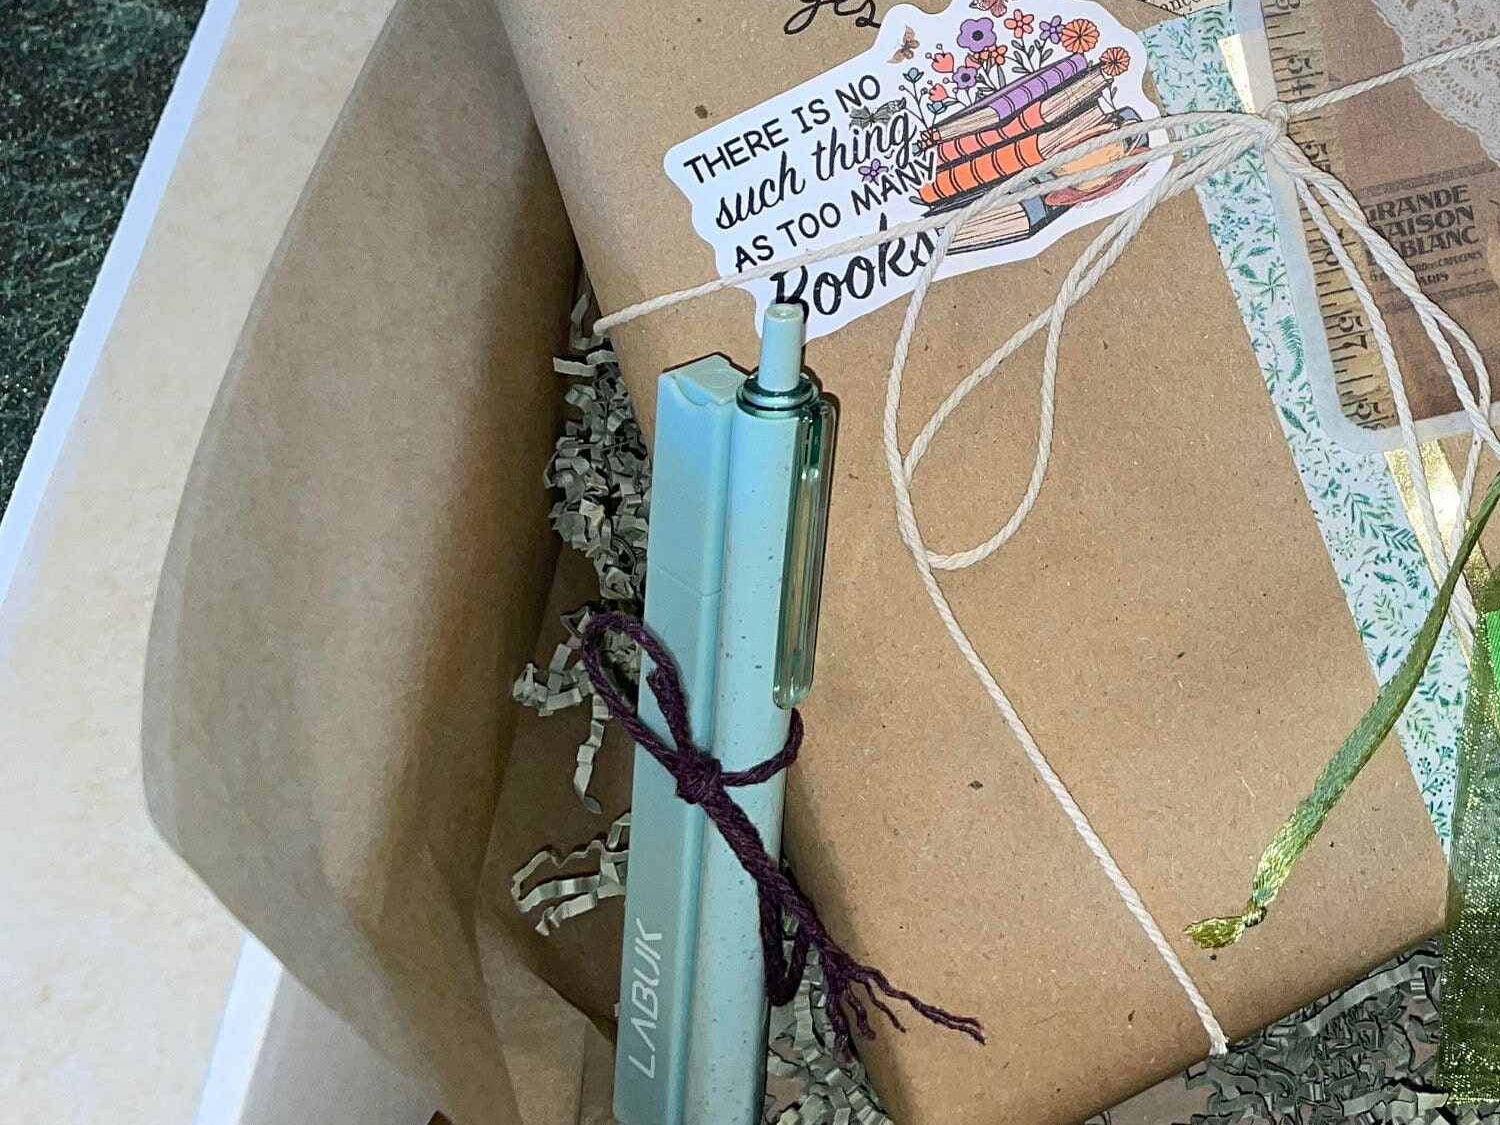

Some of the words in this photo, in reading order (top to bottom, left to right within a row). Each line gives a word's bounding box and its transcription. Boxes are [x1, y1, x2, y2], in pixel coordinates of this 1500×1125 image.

[683, 119, 788, 185] THERE
[798, 102, 831, 134] IS
[835, 74, 881, 116] NO
[715, 150, 805, 230] such
[811, 109, 919, 179] thing
[733, 235, 775, 273] AS
[776, 202, 842, 249] TOO
[853, 152, 936, 218] MANY
[1363, 184, 1471, 223] GRANDE
[1400, 225, 1479, 258] BLANC
[1338, 315, 1369, 350] 57
[628, 918, 662, 1079] LABUK
